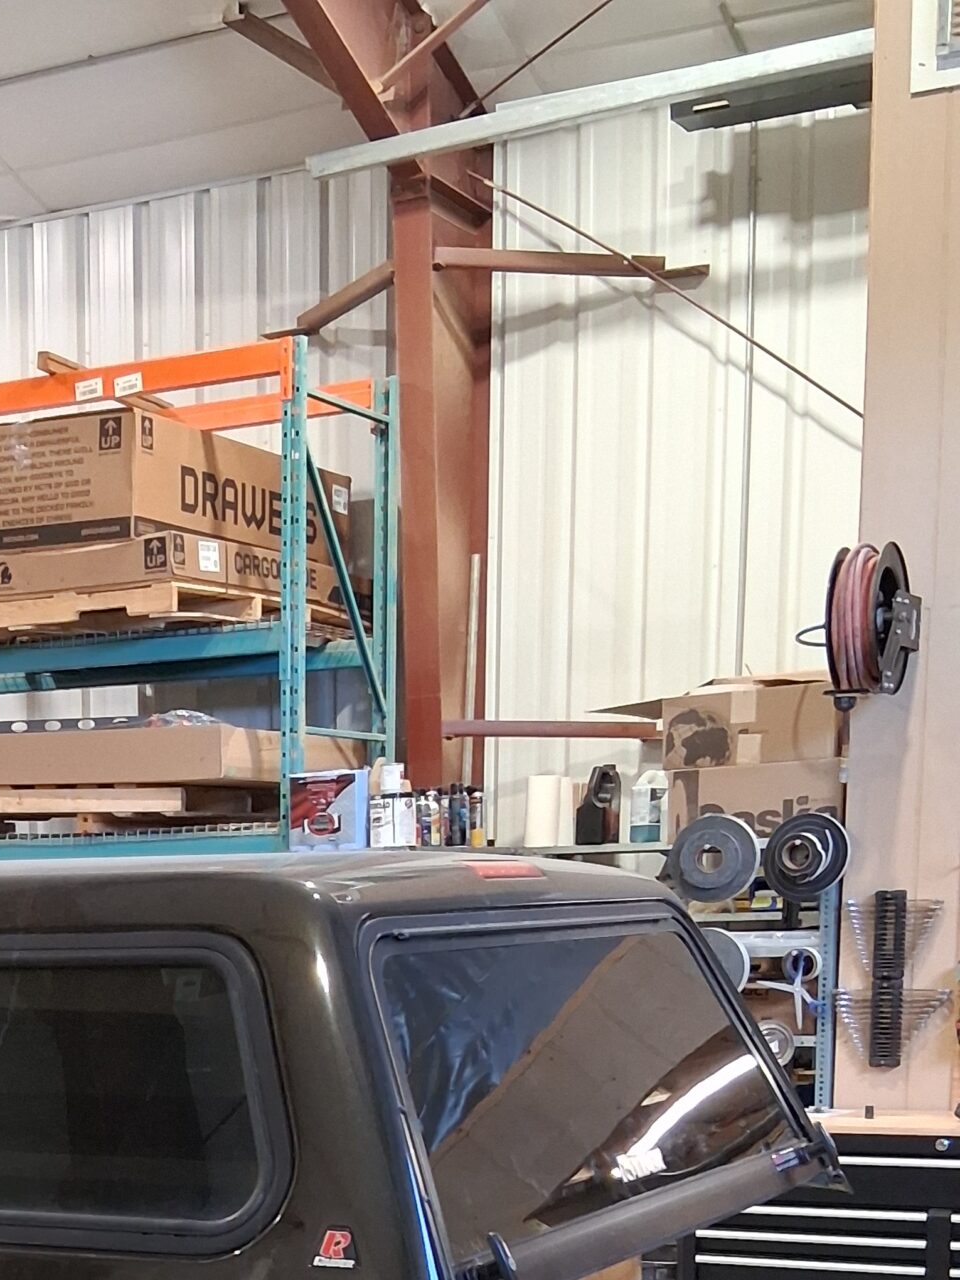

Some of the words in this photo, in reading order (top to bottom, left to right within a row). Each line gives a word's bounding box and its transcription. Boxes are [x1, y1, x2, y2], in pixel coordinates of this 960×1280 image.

[101, 435, 120, 448] UP
[181, 464, 317, 544] DRAWES
[146, 554, 165, 567] UP
